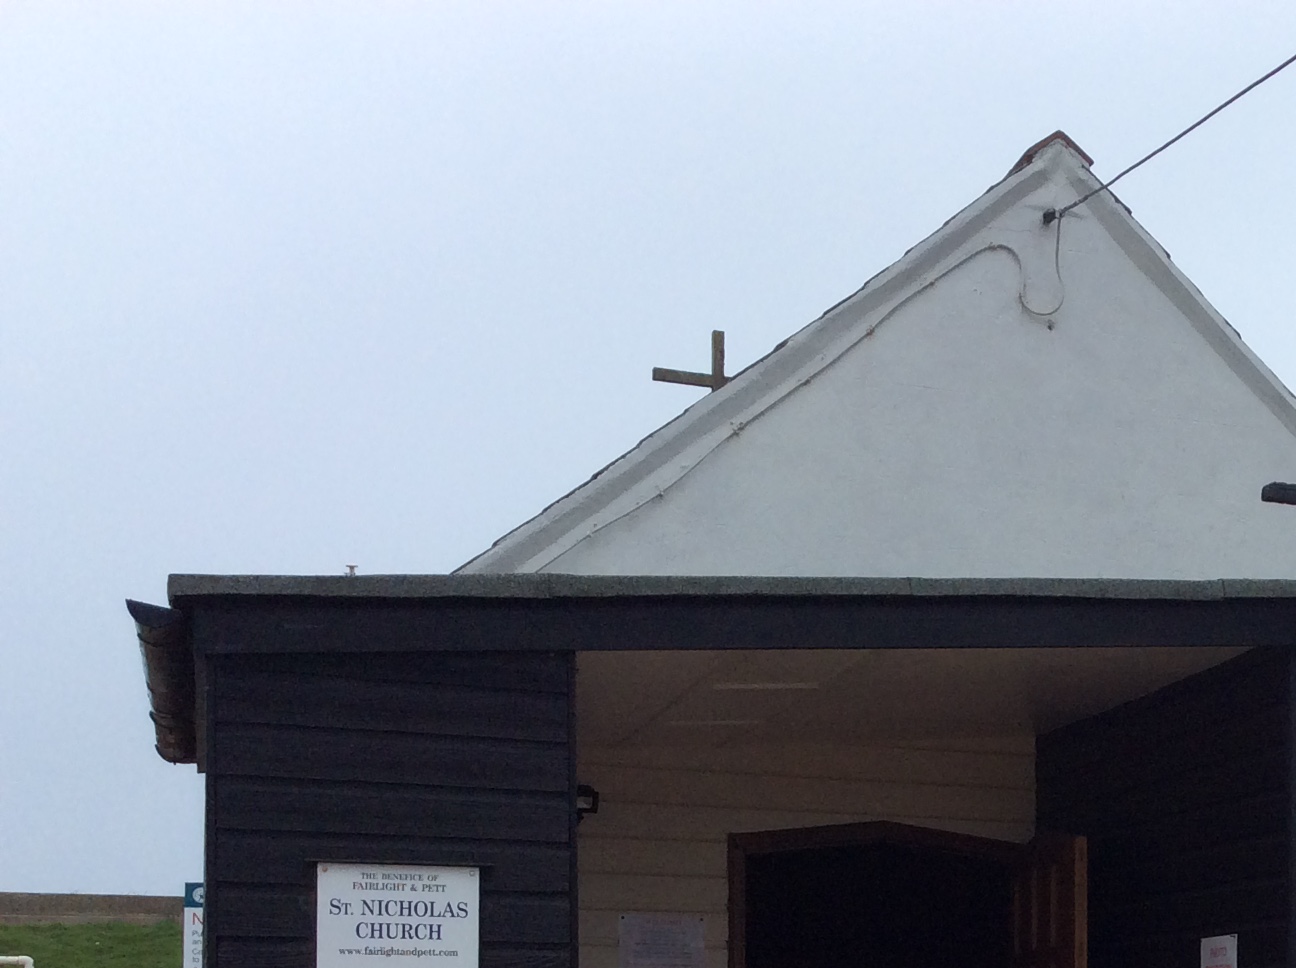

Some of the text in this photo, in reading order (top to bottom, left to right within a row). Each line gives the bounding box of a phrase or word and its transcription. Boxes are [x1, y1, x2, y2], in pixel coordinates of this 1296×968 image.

[362, 872, 439, 882] THE BENEFICE OF
[352, 882, 447, 893] FAIRLIGHT & PETT
[361, 899, 469, 918] NICHOLAS
[355, 921, 442, 941] CHURCH
[338, 946, 458, 958] www.fairlightandpett.com
